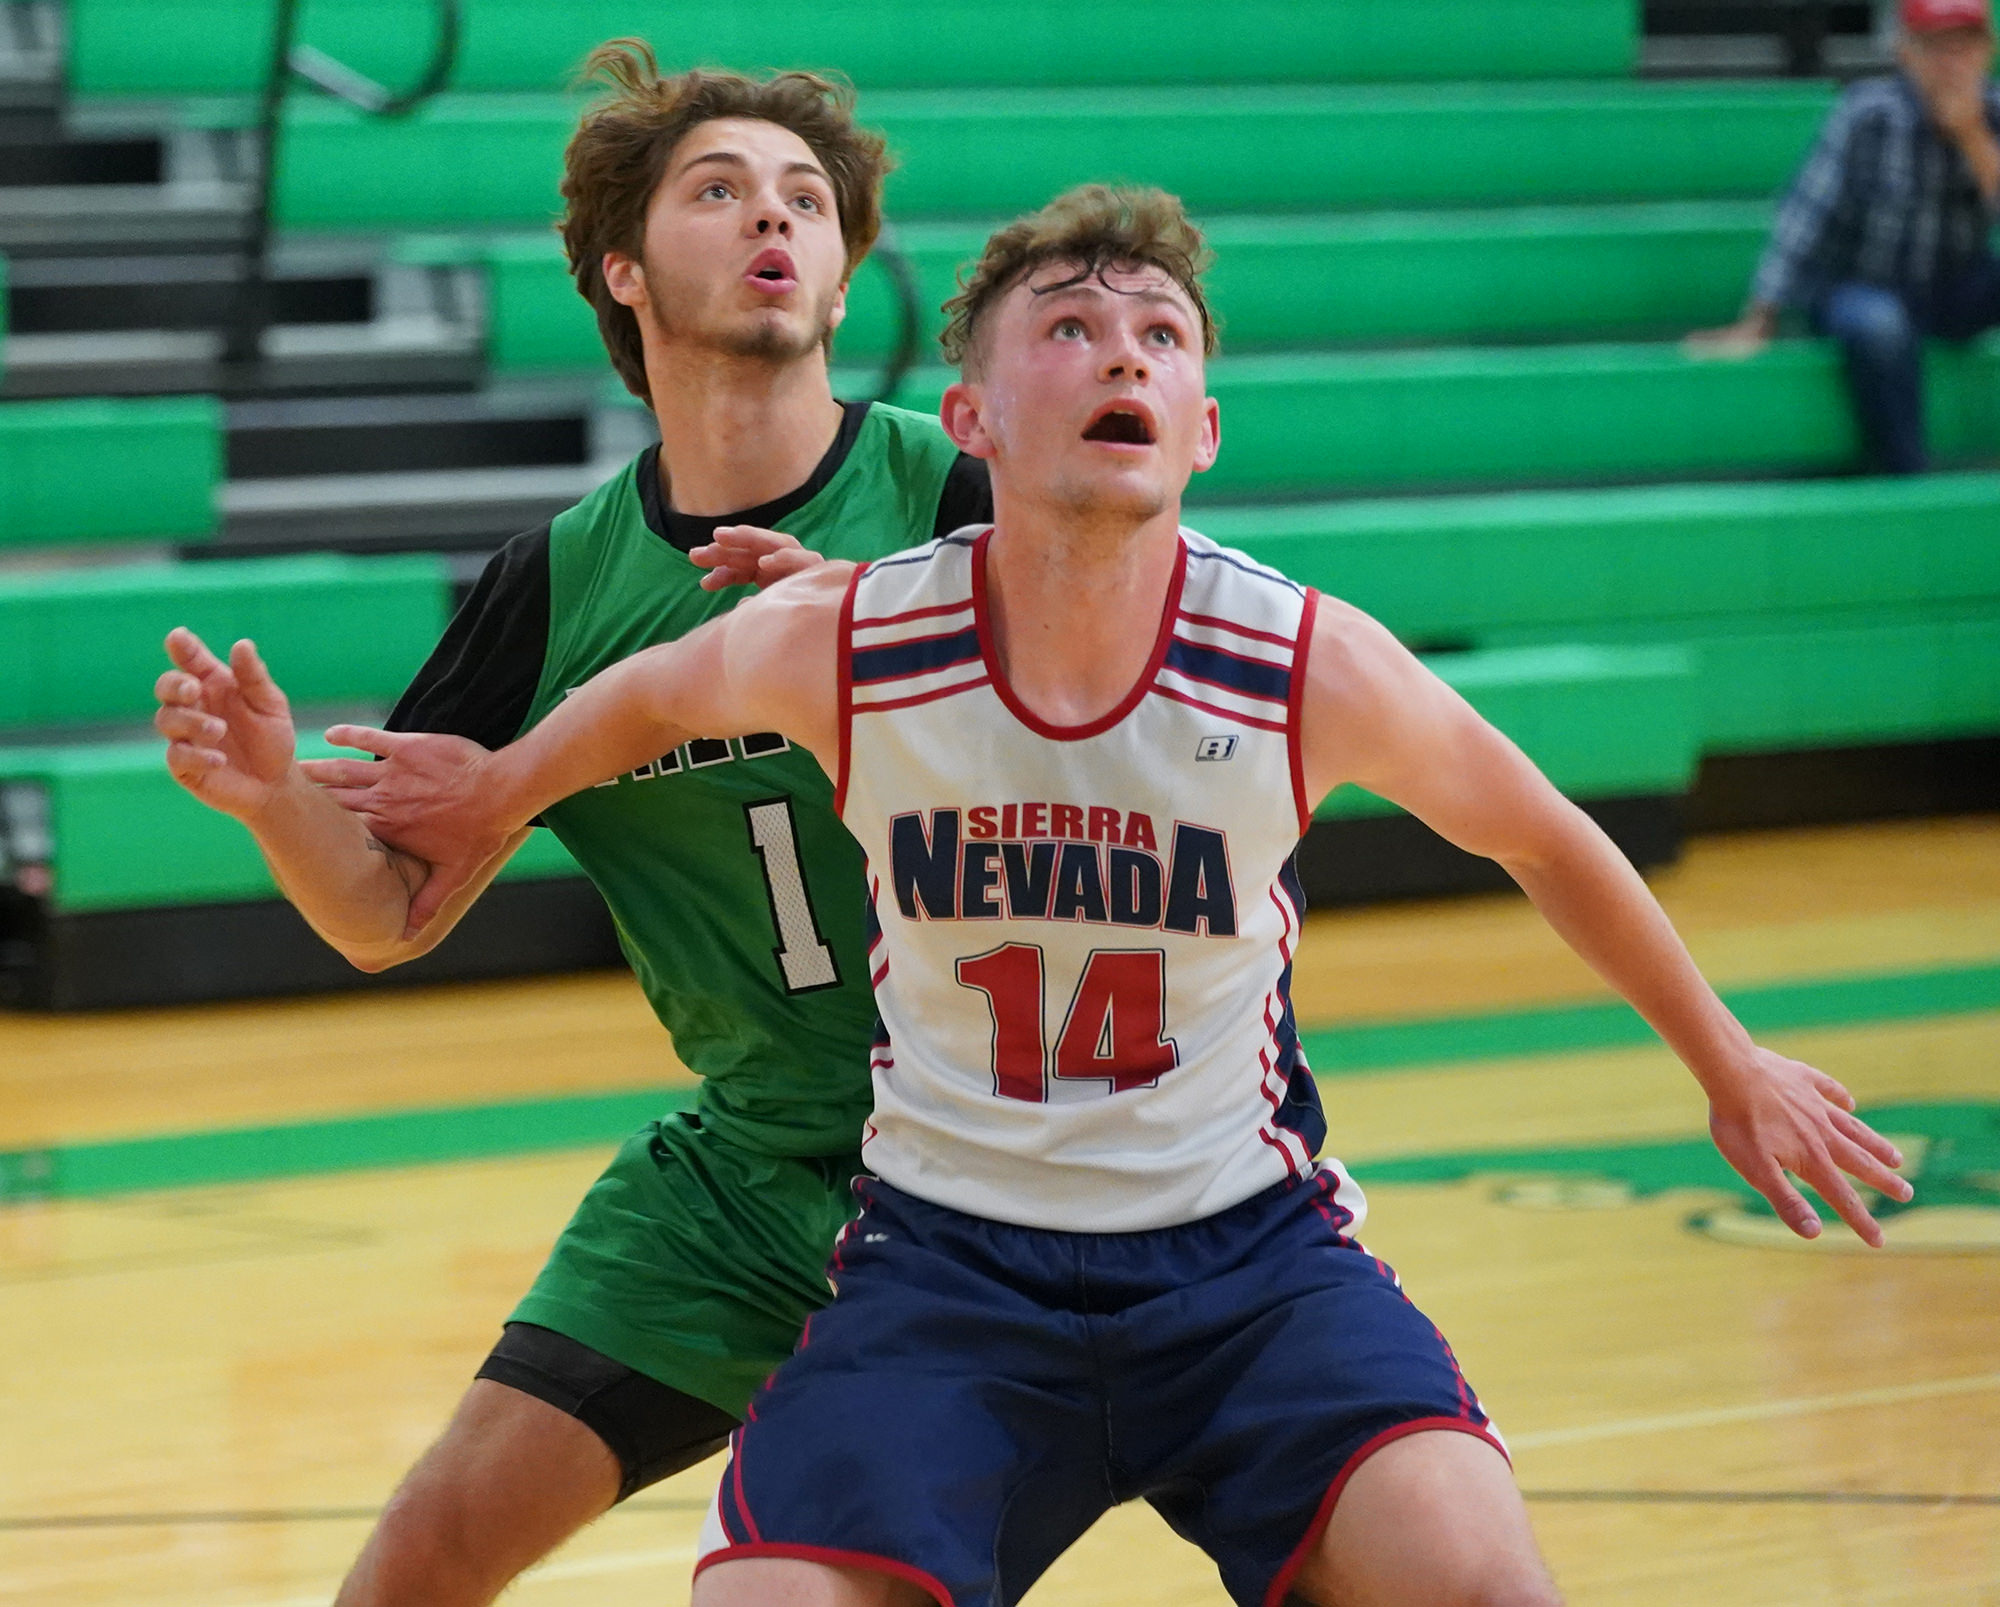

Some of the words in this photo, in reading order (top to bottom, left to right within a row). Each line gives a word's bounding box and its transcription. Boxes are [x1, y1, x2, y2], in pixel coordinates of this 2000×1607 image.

[743, 795, 843, 995] 1
[888, 806, 1239, 938] NEVADA
[967, 802, 1158, 852] SIERRA
[955, 941, 1180, 1103] 14
